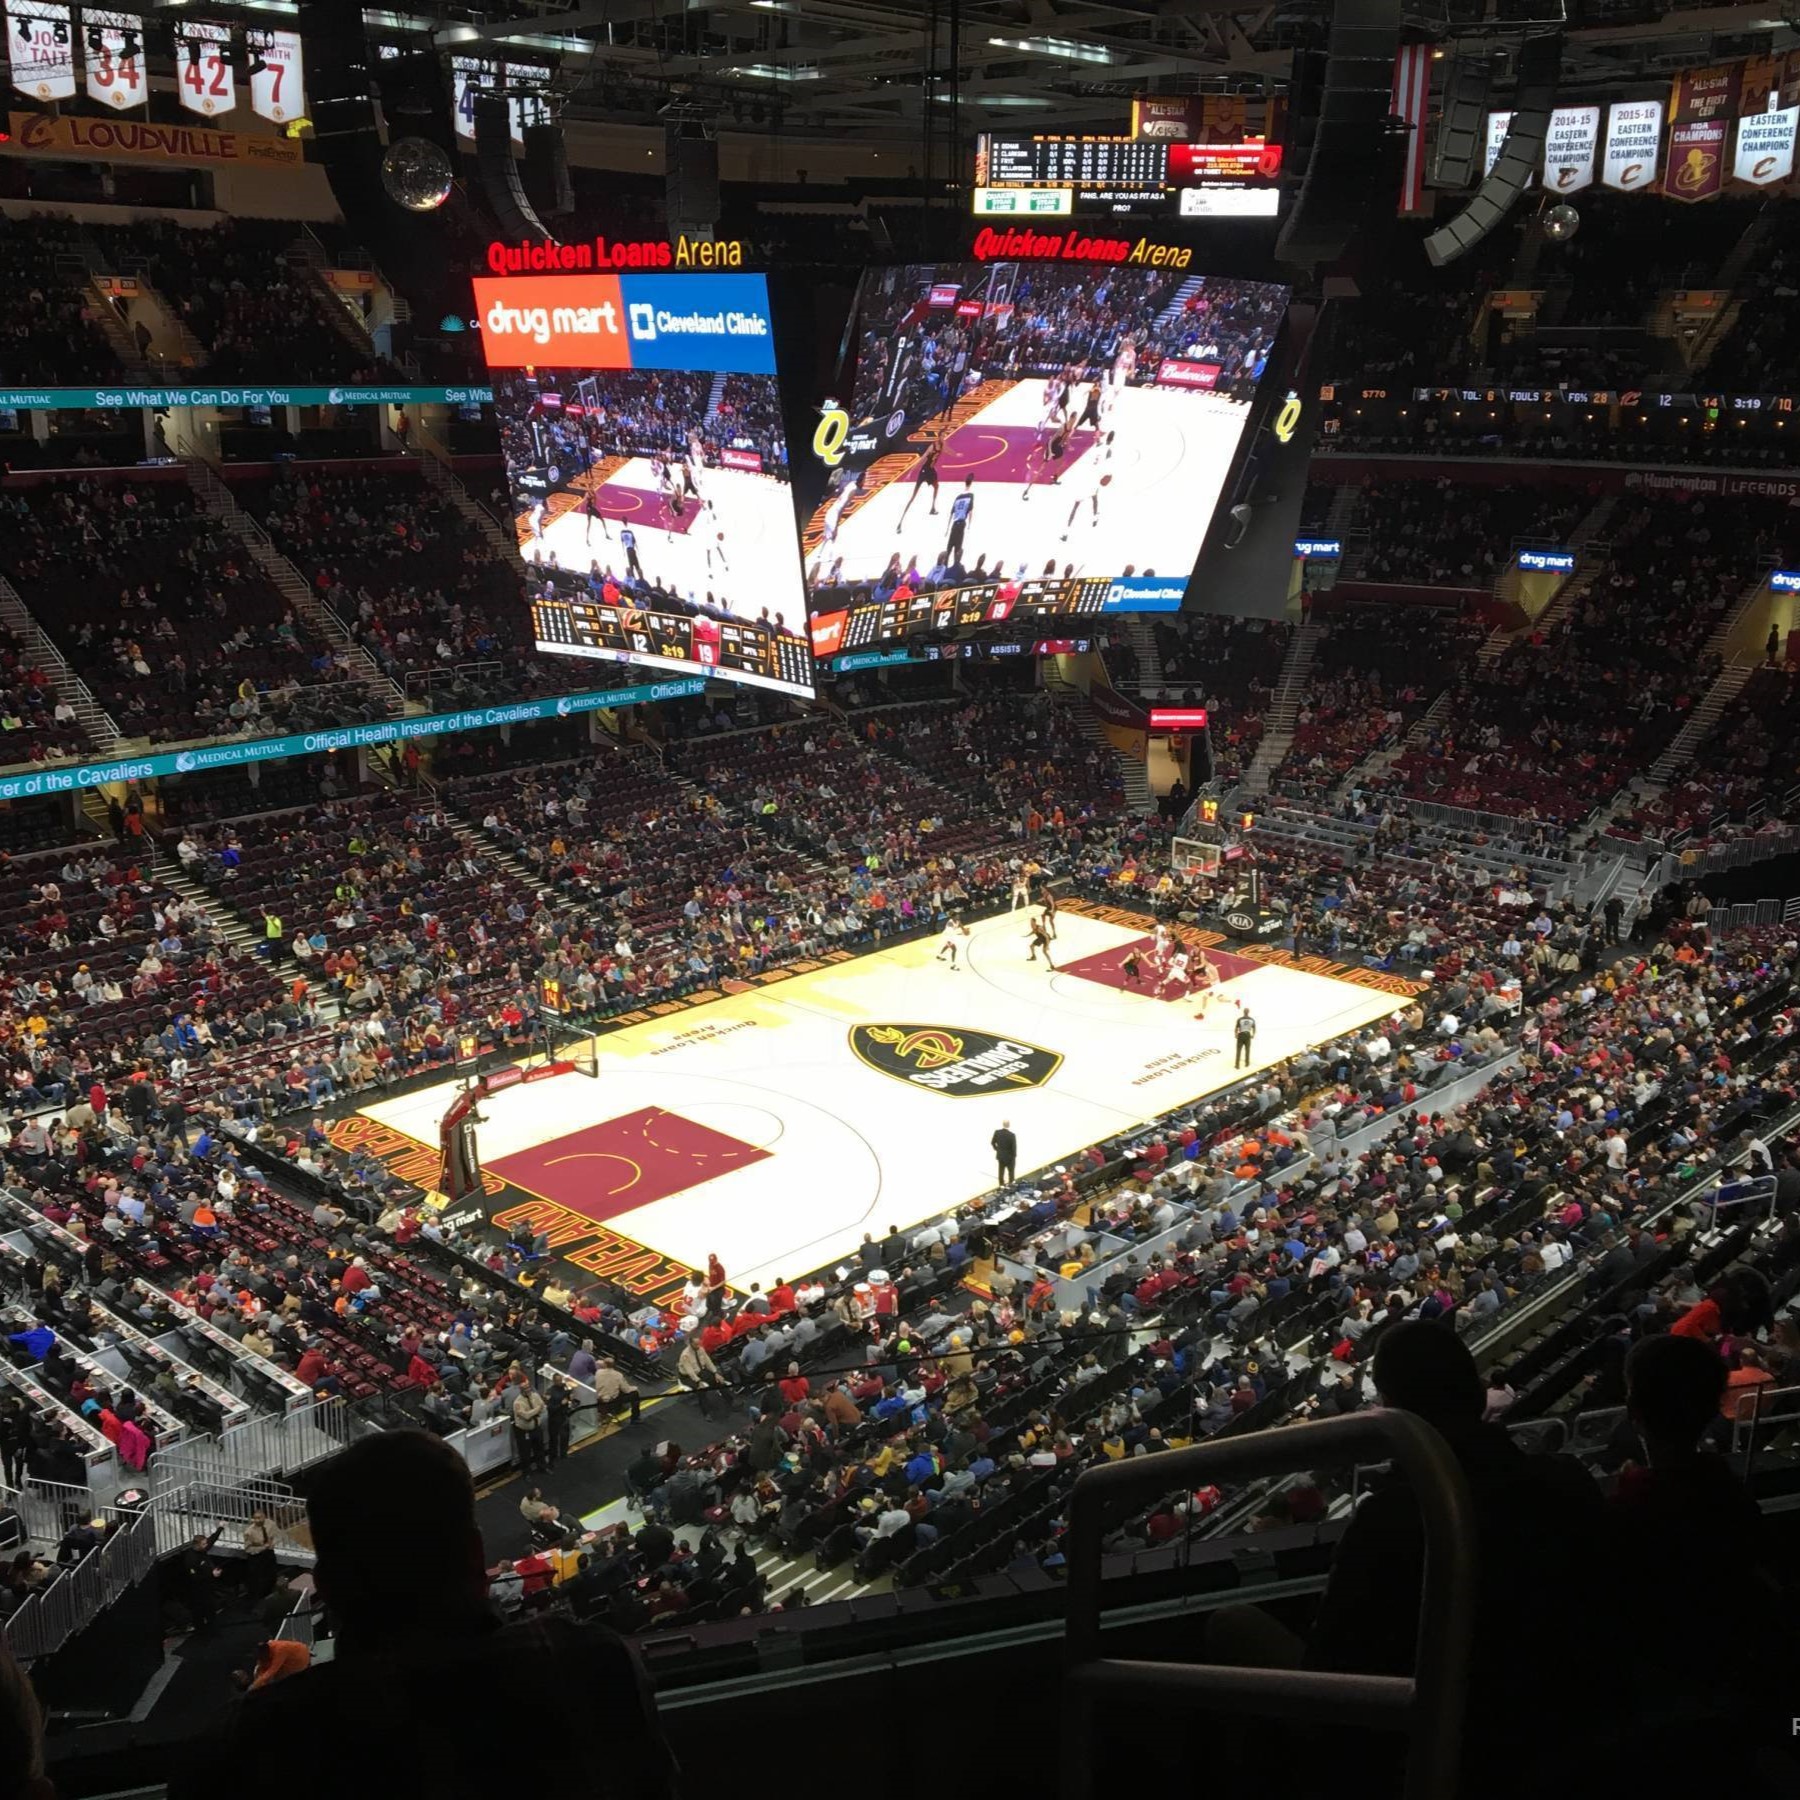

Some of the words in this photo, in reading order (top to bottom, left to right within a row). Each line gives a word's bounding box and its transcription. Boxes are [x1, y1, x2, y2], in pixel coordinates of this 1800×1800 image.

[30, 48, 68, 66] TAIT
[94, 45, 139, 89] 34
[185, 56, 228, 96] 42
[267, 63, 284, 103] 7
[1689, 97, 1705, 109] THE
[1706, 94, 1728, 106] FIRST
[1617, 109, 1655, 121] 2015-16
[1698, 105, 1716, 117] CEDI
[1555, 114, 1591, 127] 2014-15
[1750, 114, 1788, 126] EASTERN
[1554, 129, 1588, 140] EASTERN
[1618, 124, 1652, 135] EASTERN
[1674, 129, 1723, 143] CHAMPIONS
[1741, 126, 1794, 139] CONFERENCE
[69, 119, 238, 158] LOUDVILLE
[1548, 141, 1593, 152] CONFERENCE
[1609, 135, 1657, 148] CONFERENCE
[1742, 140, 1789, 153] CHAMPIONS
[1548, 152, 1590, 164] CHAMPIONS
[1610, 148, 1654, 160] CHAMPIONS
[1099, 192, 1113, 200] ARE
[1113, 192, 1129, 200] YOU
[1129, 192, 1138, 200] AS
[1139, 192, 1151, 200] FIT
[1151, 192, 1160, 200] AS
[1160, 192, 1165, 200] A
[1112, 204, 1131, 212] PRO?
[487, 240, 591, 275] Quicken
[596, 236, 672, 268] Loans
[675, 235, 742, 267] Arena
[973, 226, 1062, 261] Quicken
[1061, 230, 1129, 262] Loans
[1128, 236, 1192, 269] Arena
[487, 300, 550, 344] drug
[552, 301, 619, 334] mart
[656, 310, 724, 335] Cleveland
[726, 312, 767, 336] Clinic
[10, 394, 51, 405] MUTUAL
[95, 391, 122, 406] See
[126, 391, 162, 405] What
[165, 391, 187, 405] We
[191, 391, 217, 405] Can
[220, 390, 239, 404] Do
[242, 390, 263, 404] For
[266, 390, 289, 404] You
[345, 391, 378, 401] MEDICAL
[379, 390, 411, 401] MUTUAL
[445, 388, 466, 402] See
[1435, 390, 1449, 401] -7
[1462, 390, 1482, 401] TOL:
[1486, 390, 1495, 402] 6
[1510, 391, 1539, 402] FOULS
[1544, 391, 1552, 403] 2
[1568, 392, 1588, 403] FG%
[1593, 392, 1607, 404] 28
[1660, 394, 1672, 407] 12
[1702, 396, 1718, 408] 14
[1734, 397, 1761, 409] 3:19
[1275, 398, 1302, 443] Q
[813, 409, 849, 465] Q
[1312, 541, 1340, 552] mart
[1520, 552, 1546, 569] drug
[1546, 553, 1573, 568] mart
[1772, 572, 1800, 588] drug
[937, 611, 951, 627] 12
[960, 611, 981, 624] 3:19
[992, 602, 1006, 619] 19
[608, 624, 615, 633] 2
[632, 633, 648, 653] 12
[661, 644, 685, 659] 3:19
[964, 646, 972, 657] 3
[990, 644, 1021, 655] ASSISTS
[1039, 642, 1047, 653] 4
[698, 644, 713, 663] 19
[851, 656, 879, 667] MEDICAL
[25, 777, 42, 794] of
[46, 774, 73, 791] the
[77, 761, 153, 785] Cavaliers
[197, 749, 242, 764] MEDICAL
[244, 743, 285, 759] MUTUAL
[304, 731, 351, 751] Official
[355, 723, 397, 742] Health
[401, 718, 444, 736] Insurer
[448, 715, 461, 730] of
[463, 710, 482, 727] the
[486, 703, 541, 724] Cavaliers
[571, 696, 605, 709] MEDICAL
[606, 691, 637, 704] MUTUAL
[651, 683, 685, 699] Official
[1231, 915, 1249, 928] KIA
[672, 1024, 716, 1041] Arena
[696, 1019, 758, 1042] Quicken
[650, 1038, 697, 1056] Loans
[909, 1040, 1034, 1089] CAVALIERS
[1143, 1052, 1182, 1070] Arena
[1169, 1048, 1222, 1070] Quicken
[1131, 1067, 1173, 1086] Loans
[455, 1207, 484, 1228] mart
